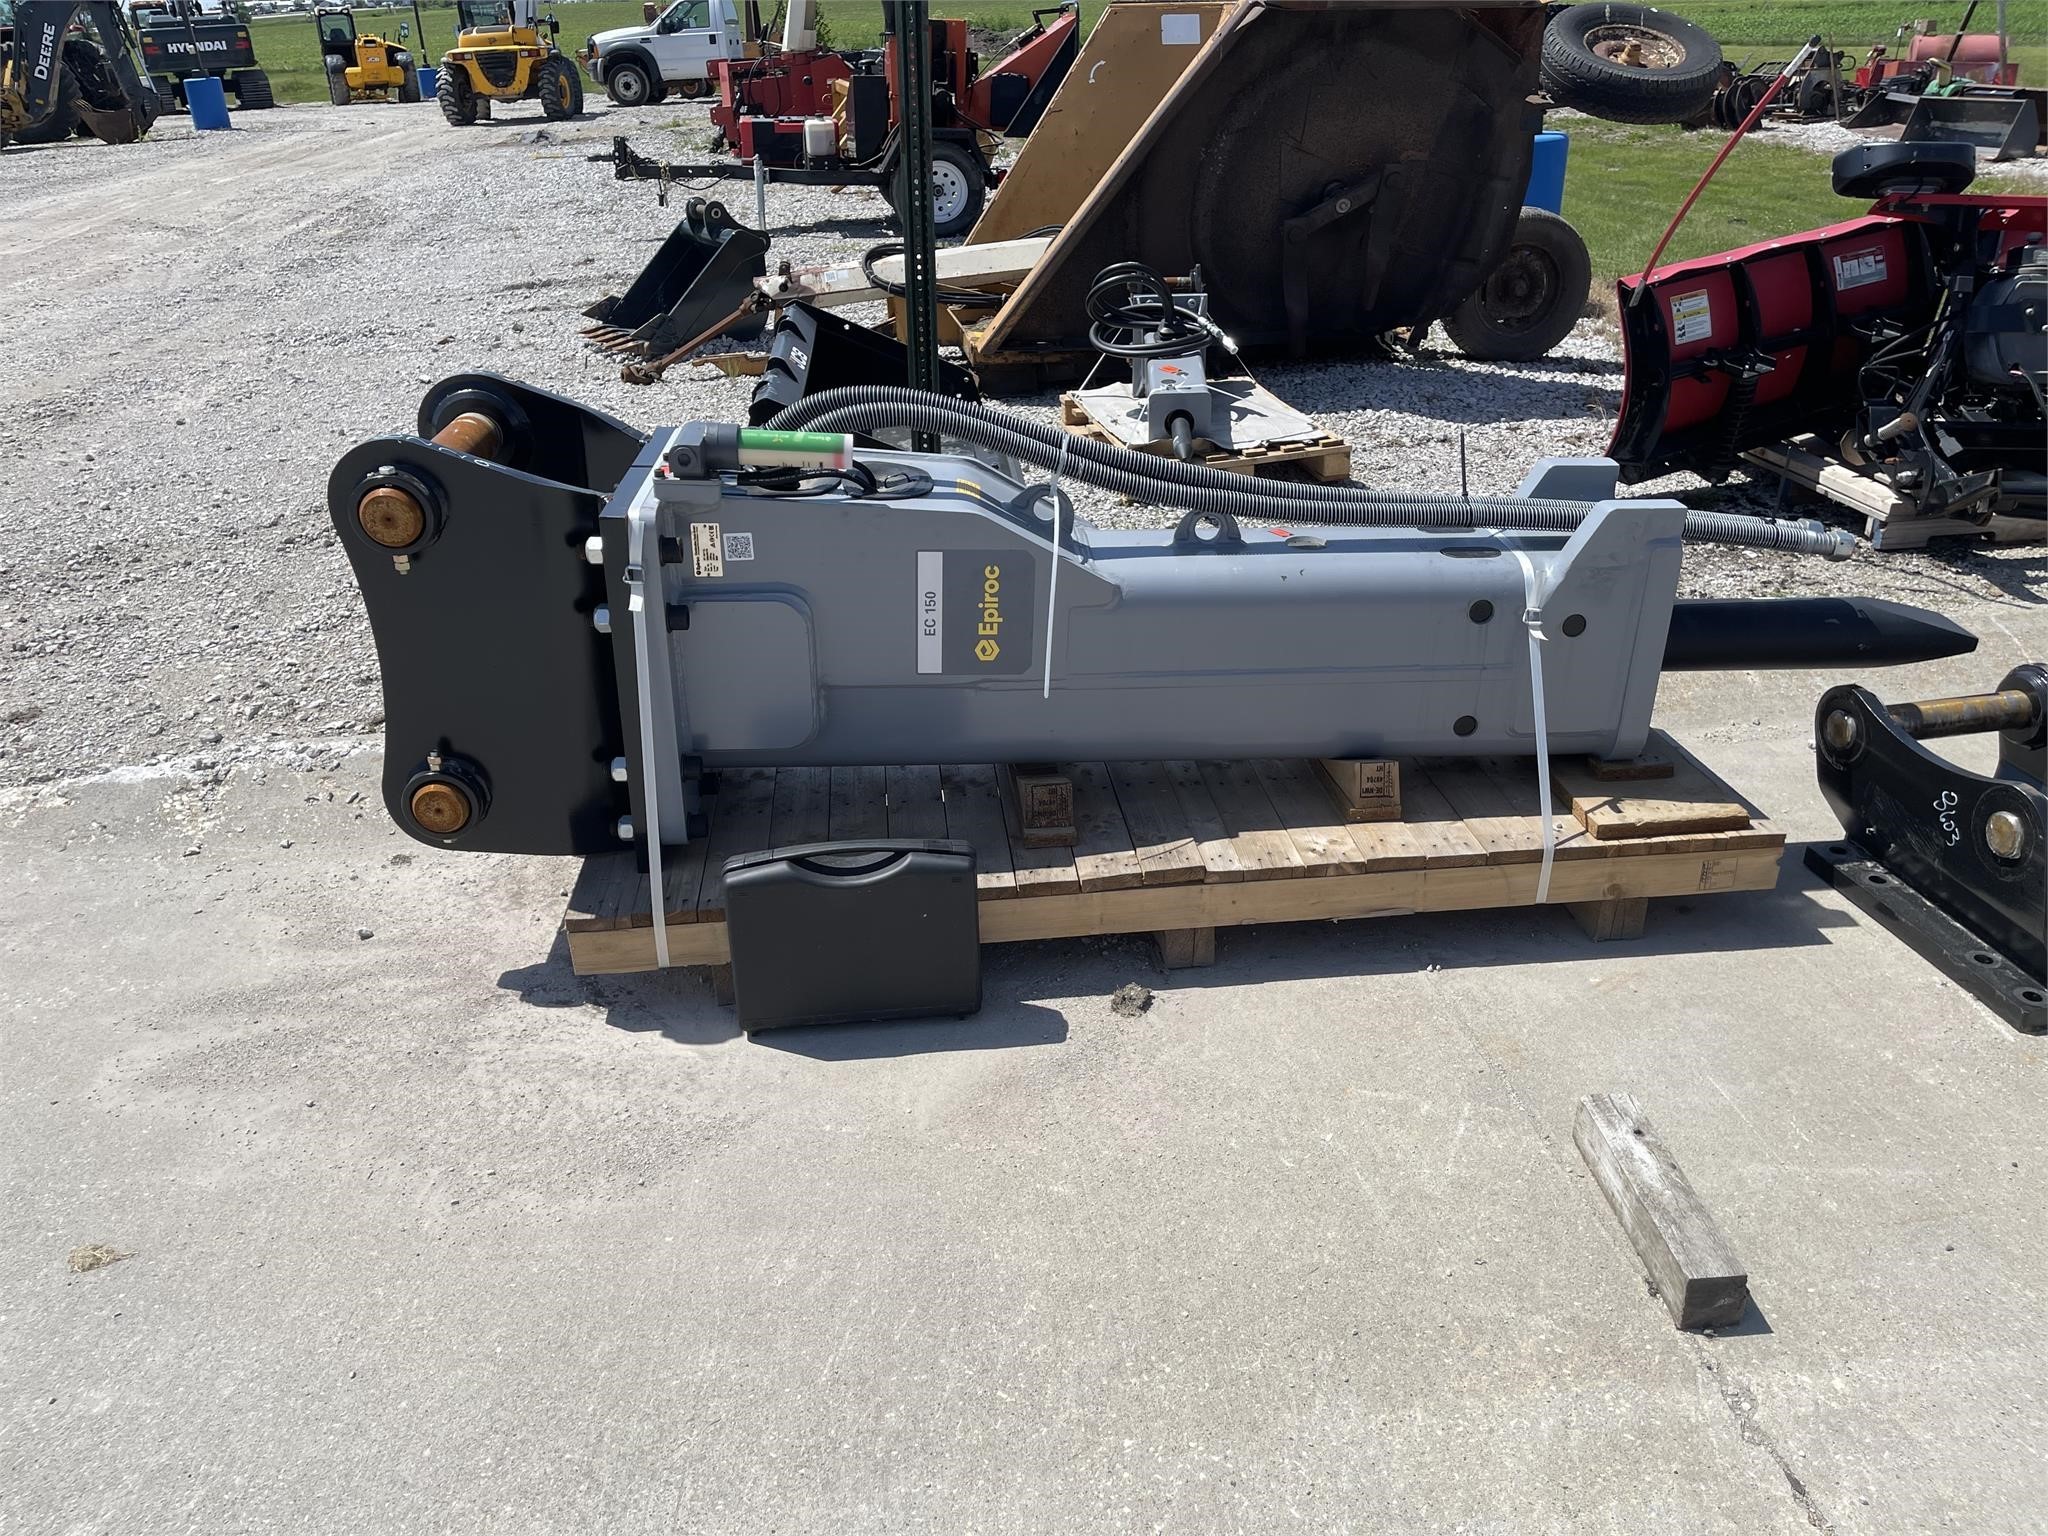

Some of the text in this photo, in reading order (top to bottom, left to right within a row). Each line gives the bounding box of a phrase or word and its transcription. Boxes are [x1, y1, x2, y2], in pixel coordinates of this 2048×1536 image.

[33, 22, 56, 81] DEERE
[789, 346, 808, 370] JCB
[924, 591, 937, 637] EC 150
[977, 565, 1003, 635] Epiroc
